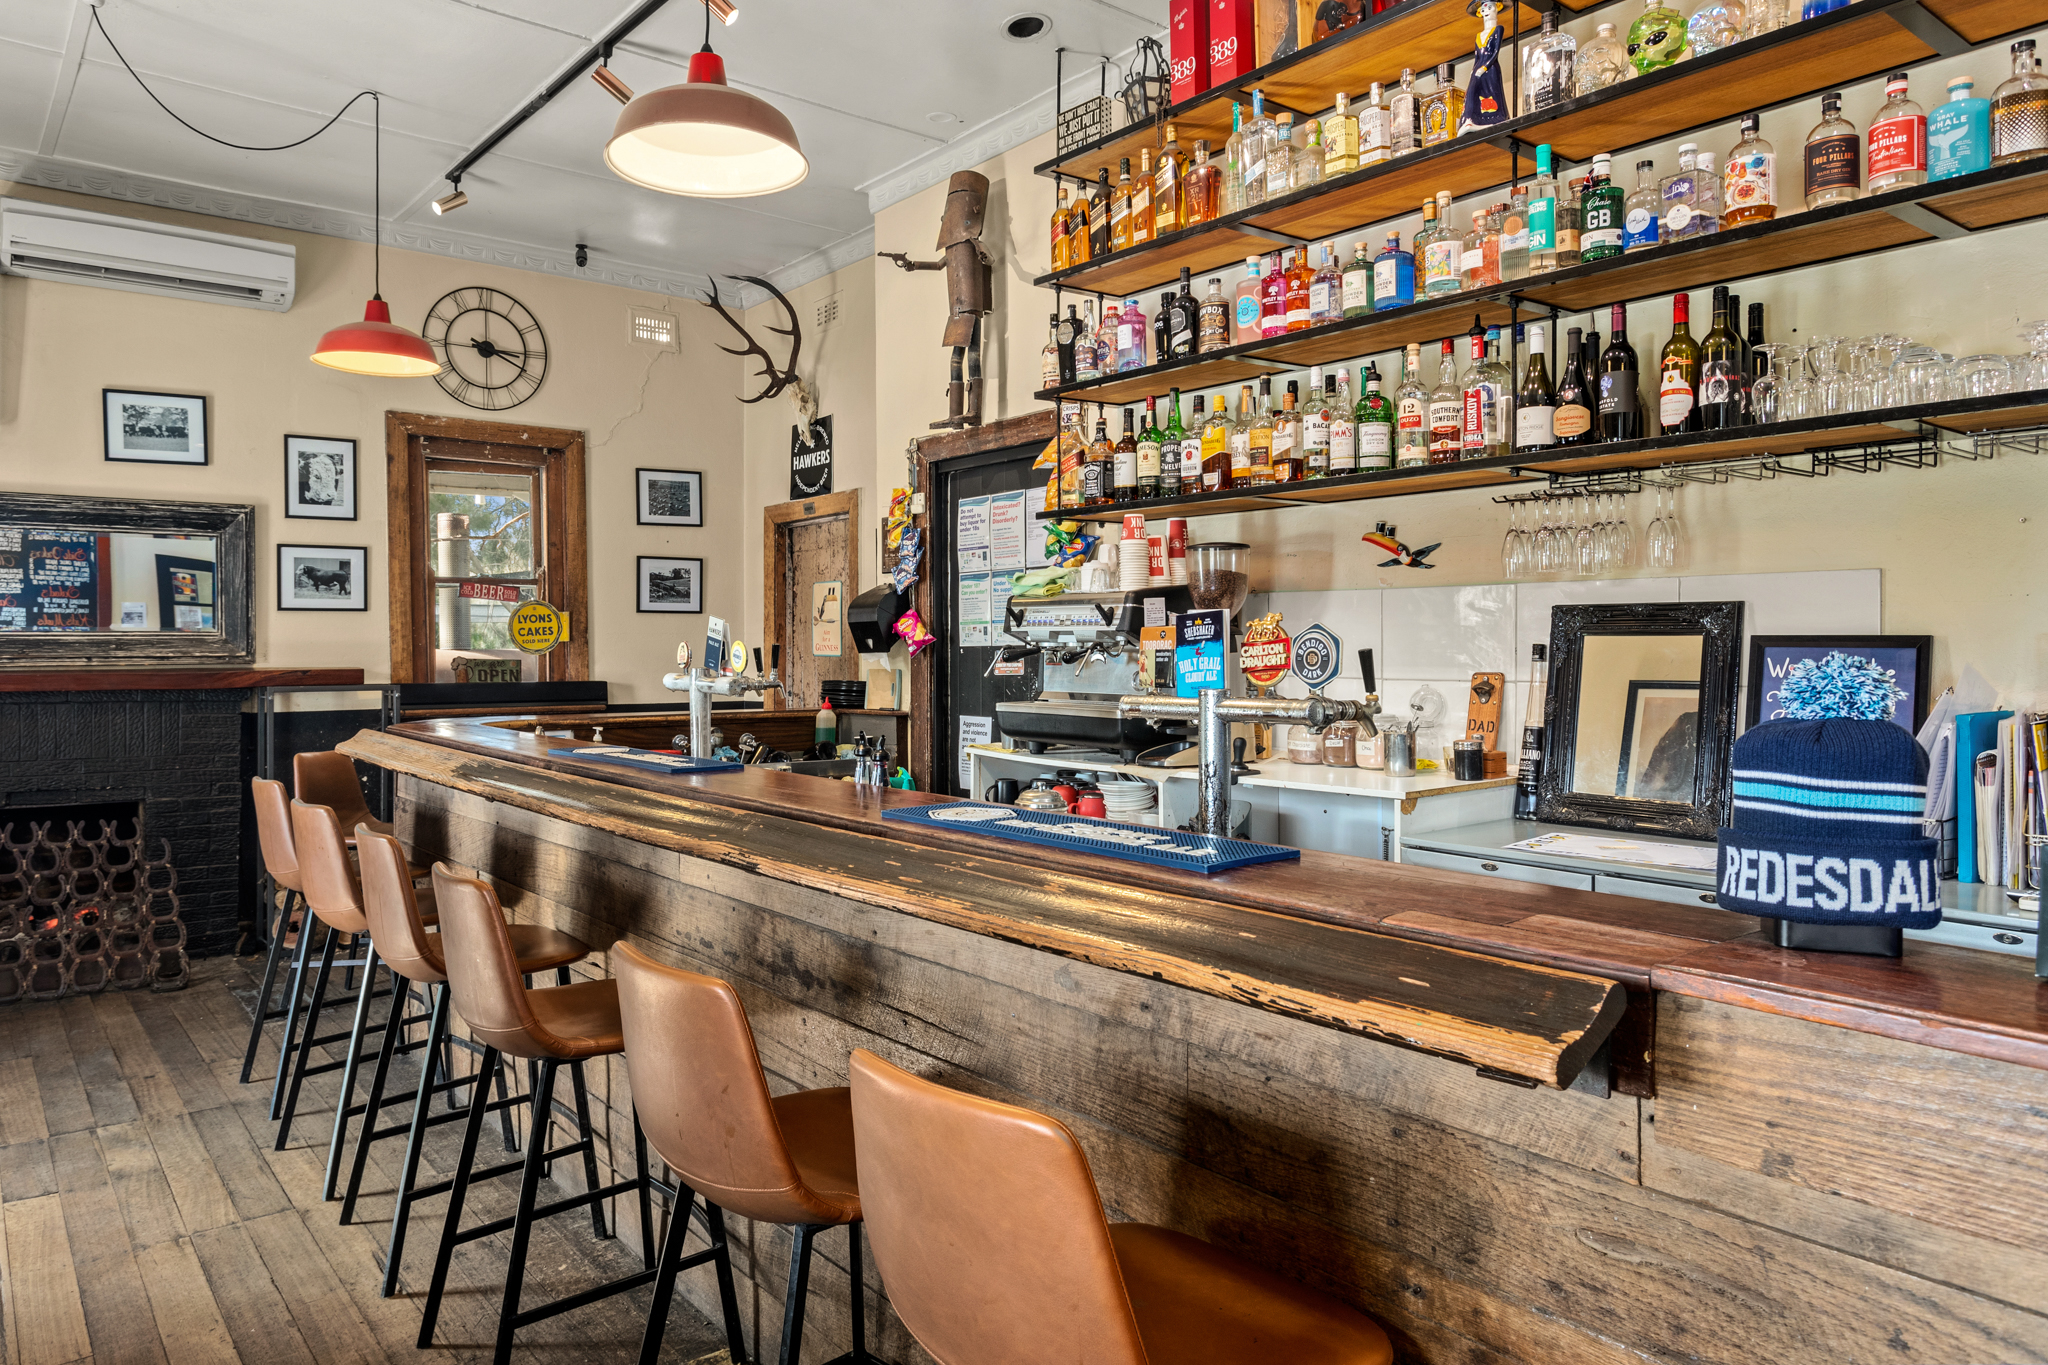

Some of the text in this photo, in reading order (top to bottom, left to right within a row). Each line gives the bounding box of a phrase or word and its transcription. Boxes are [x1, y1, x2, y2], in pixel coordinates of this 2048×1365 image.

[1210, 36, 1238, 65] 389
[1170, 56, 1196, 84] 389
[1058, 108, 1100, 138] WE JUST PUT IT
[1930, 114, 1969, 132] WHALE
[1936, 112, 1955, 122] GRAY
[1879, 134, 1907, 148] PILLARS
[1812, 152, 1854, 166] FOUR PILLARS
[1586, 196, 1612, 210] Chase
[1587, 208, 1611, 230] GB
[1529, 232, 1546, 248] GIN
[1582, 234, 1594, 244] GIN
[1403, 403, 1416, 415] 12
[1430, 406, 1460, 417] SOUTHERN
[1466, 397, 1478, 431] RUSKOV
[1400, 416, 1420, 424] OUZO
[1432, 414, 1458, 424] COMFORT
[1464, 433, 1484, 442] VODKA
[793, 448, 830, 470] HAWKERS
[794, 467, 828, 494] INDEPENDENT BEER
[992, 502, 1021, 510] Intoxicated?
[992, 516, 1018, 524] Disorderly?
[474, 583, 504, 600] BEER
[518, 614, 552, 624] LYONS
[518, 626, 554, 637] CAKES
[1184, 624, 1216, 639] SHEDSHAKER
[814, 642, 838, 652] GUINNESS
[1142, 640, 1172, 650] TOOBORAC
[1241, 643, 1284, 657] CARLTON
[1298, 640, 1328, 656] BENDIGO
[1178, 656, 1220, 674] HOLY GRAIL
[1240, 654, 1286, 669] DRAUGHT
[478, 668, 519, 682] OPEN
[1184, 670, 1218, 684] CLOUDY ALE
[1302, 668, 1322, 679] DARK
[962, 720, 986, 729] Aggression
[1468, 718, 1495, 733] DAD
[970, 728, 988, 736] violence
